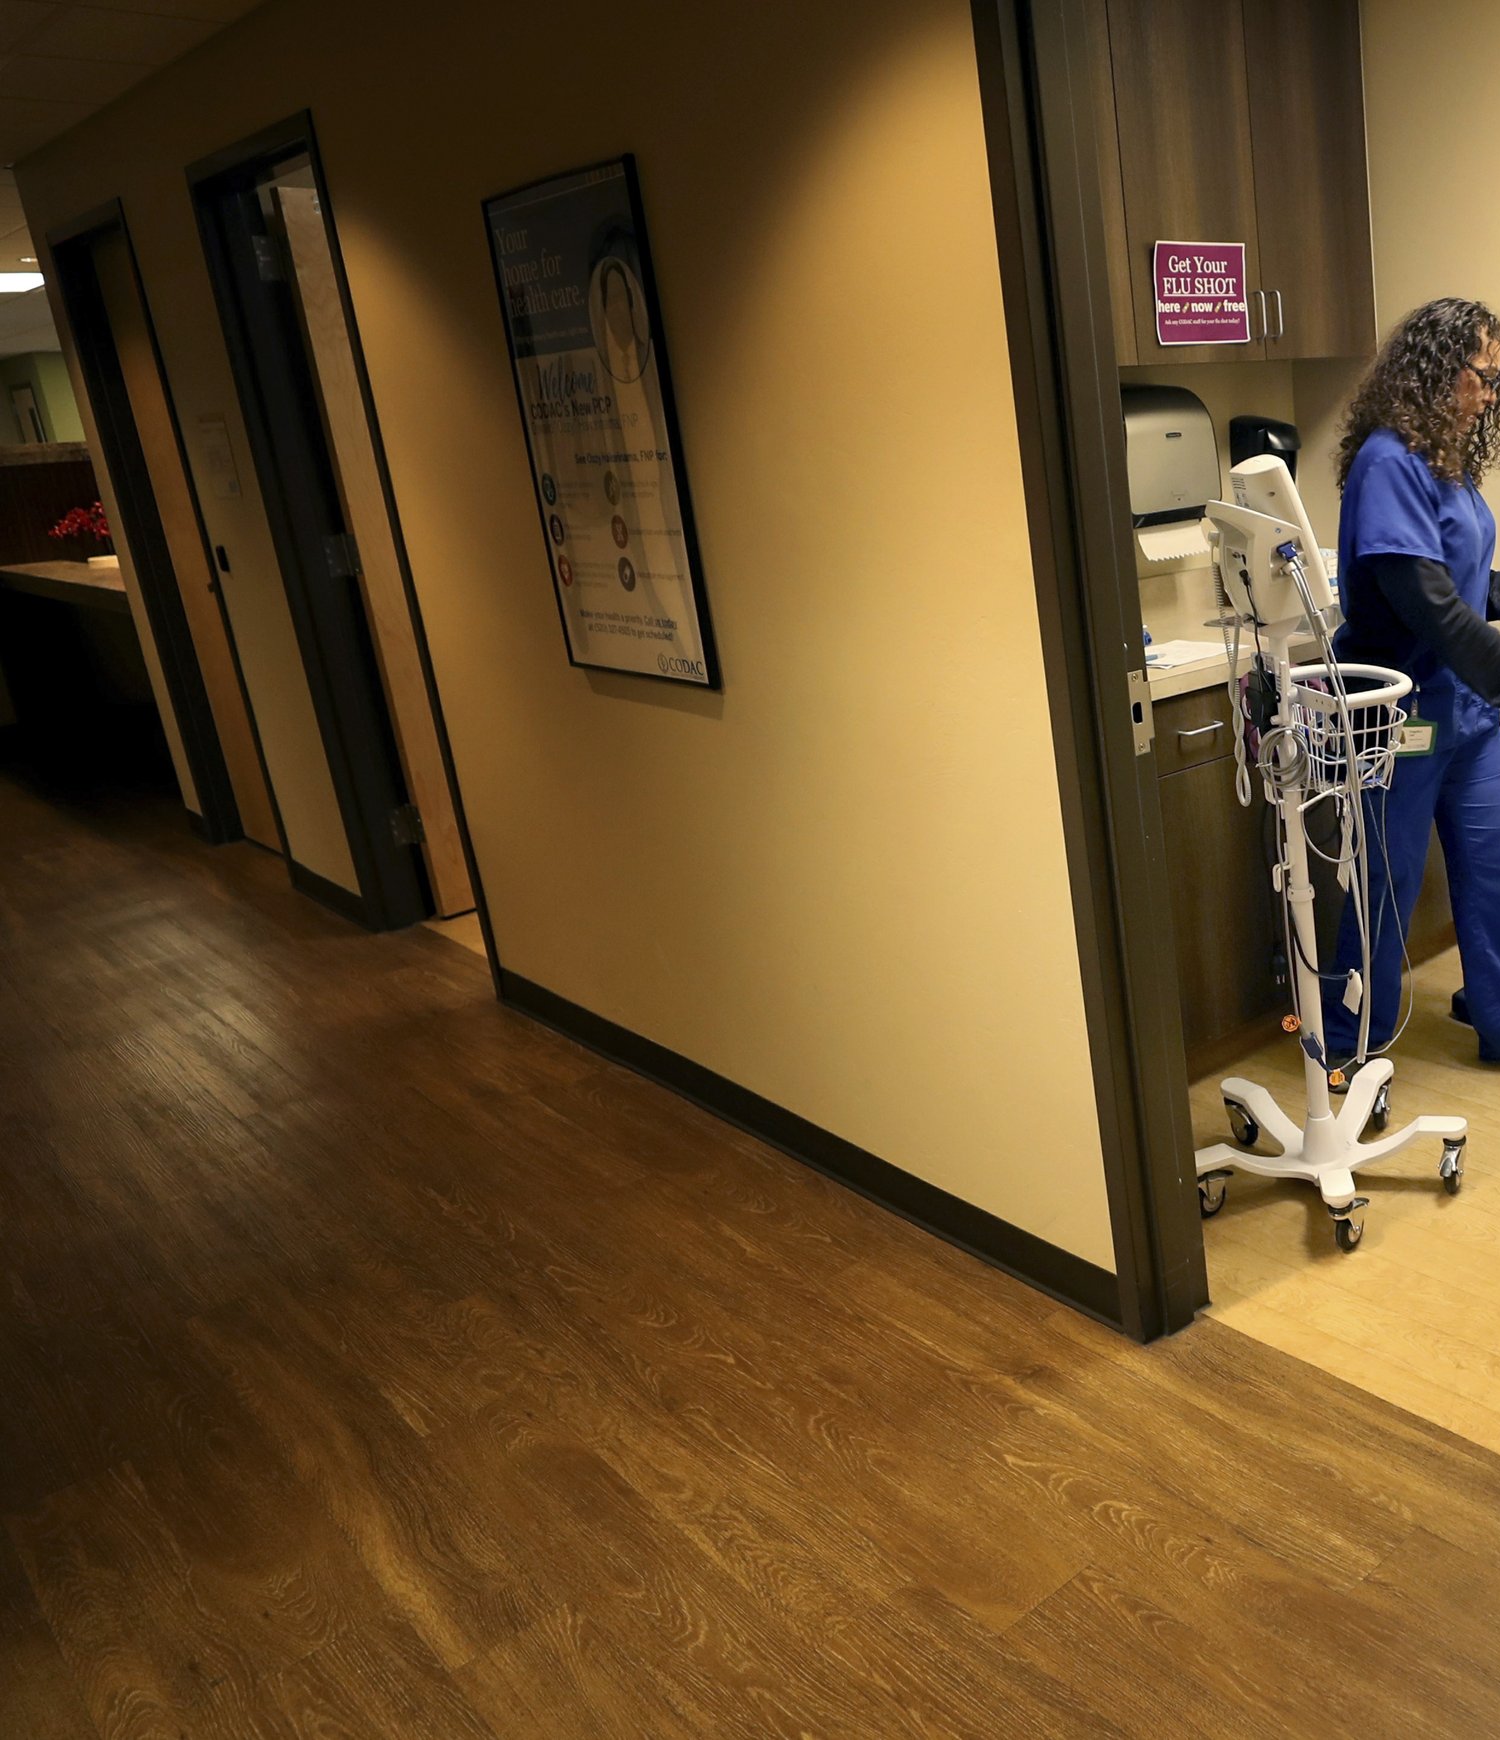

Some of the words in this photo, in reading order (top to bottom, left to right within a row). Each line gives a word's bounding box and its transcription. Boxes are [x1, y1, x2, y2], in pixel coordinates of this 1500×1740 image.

[495, 228, 528, 255] Your
[502, 259, 538, 286] home
[540, 248, 562, 278] for
[1168, 256, 1192, 273] Get
[1193, 256, 1228, 273] Your
[1163, 278, 1191, 294] FLU
[1194, 278, 1236, 294] SHOT
[508, 284, 549, 316] health
[551, 284, 586, 311] care.
[1158, 300, 1181, 313] here
[1191, 302, 1213, 313] now
[1224, 300, 1245, 313] free
[536, 355, 595, 402] Welcome
[530, 401, 570, 419] CODAC's
[570, 400, 591, 417] New
[592, 396, 611, 415] PCP
[669, 657, 704, 676] CODAC
